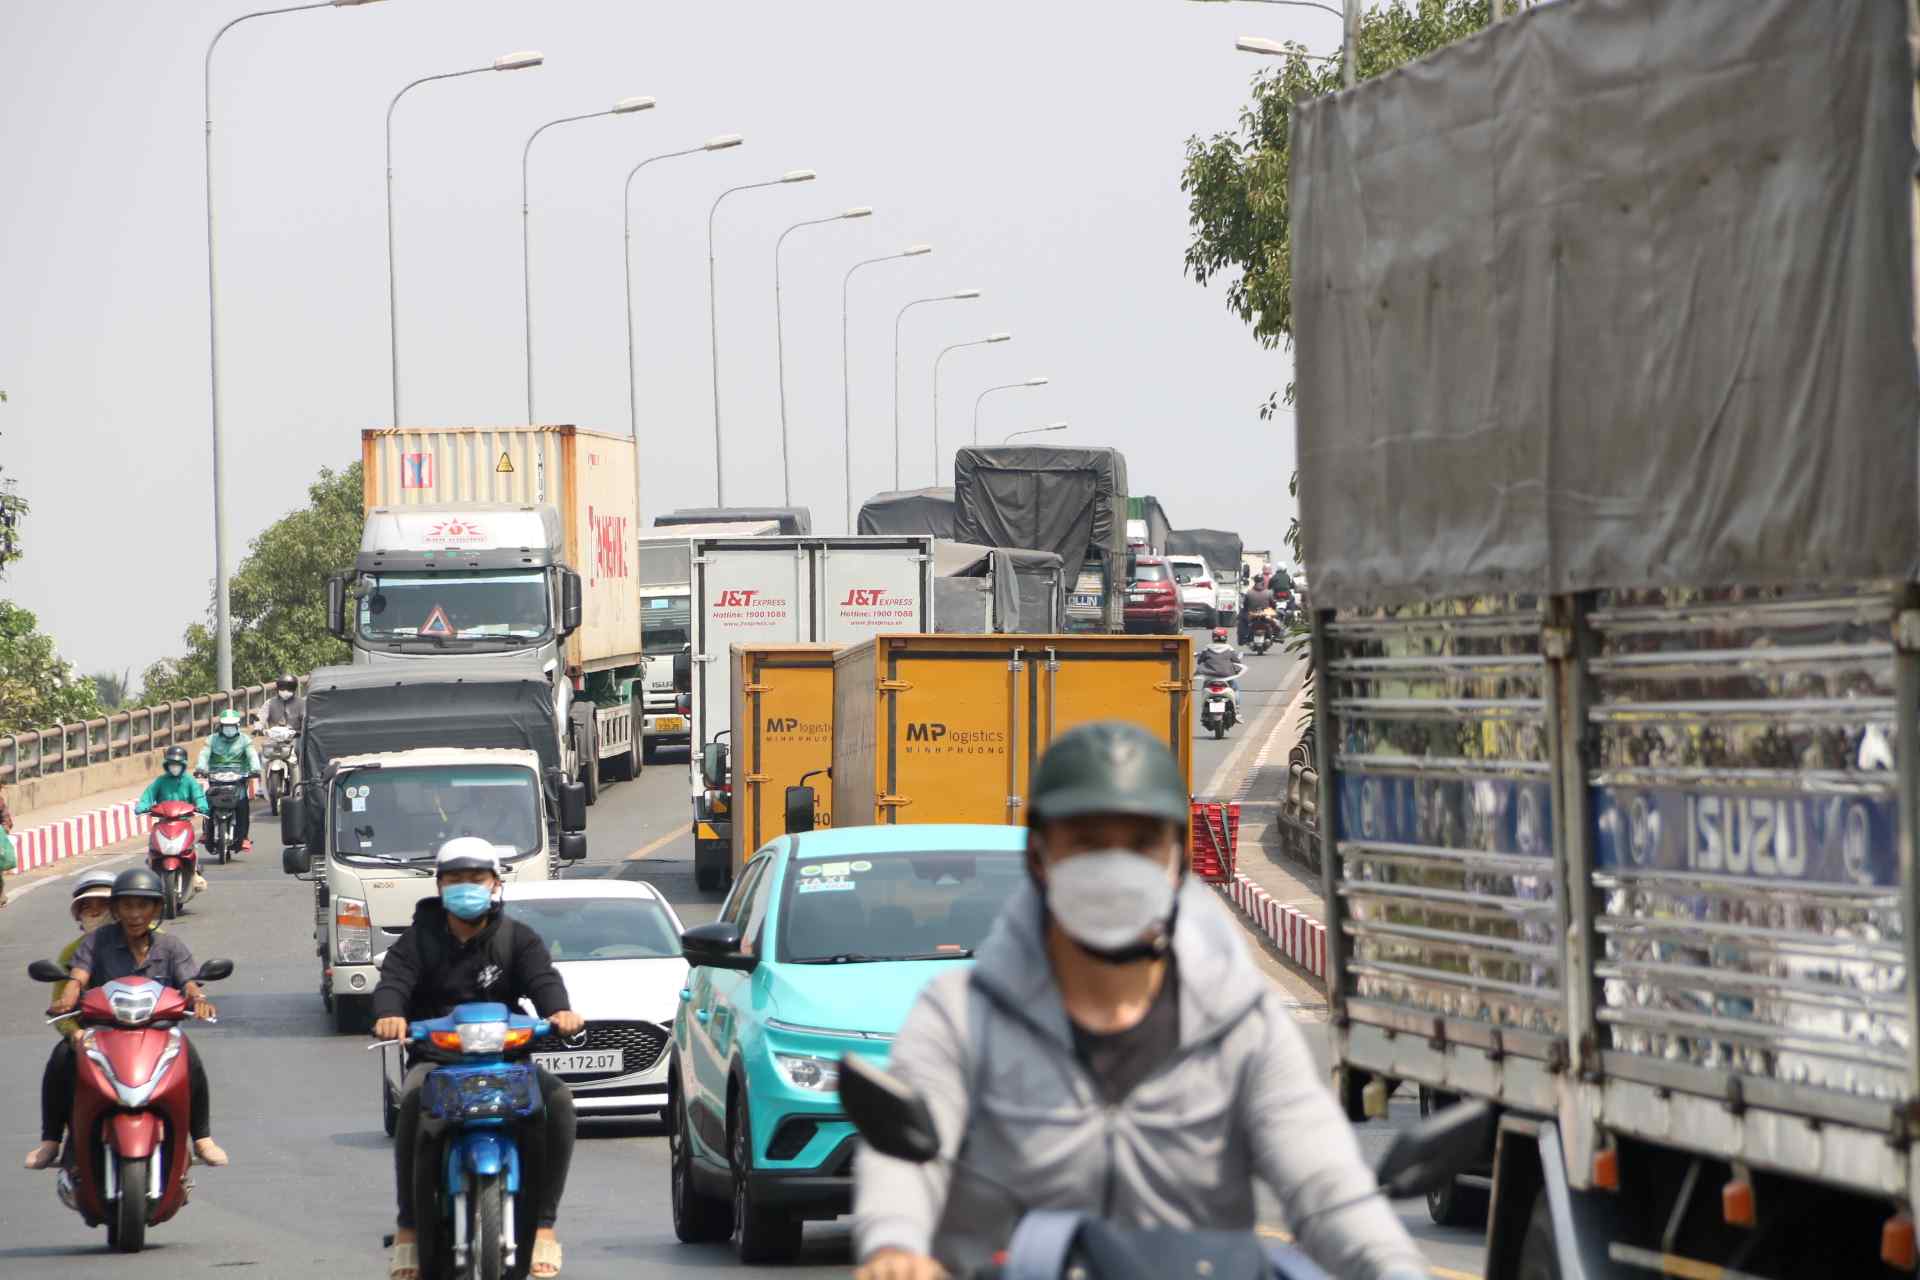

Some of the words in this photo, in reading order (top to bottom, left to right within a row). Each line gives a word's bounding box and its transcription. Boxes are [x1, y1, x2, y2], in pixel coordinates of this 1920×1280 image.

[713, 590, 758, 607] J&T
[753, 599, 786, 607] EXPRESS
[840, 589, 887, 606] J&T
[879, 598, 913, 606] EXPRESS
[766, 718, 798, 733] MP
[799, 722, 832, 735] logisti
[906, 723, 947, 741] MP
[948, 730, 1005, 744] logistics
[1687, 796, 1806, 875] ISUZU
